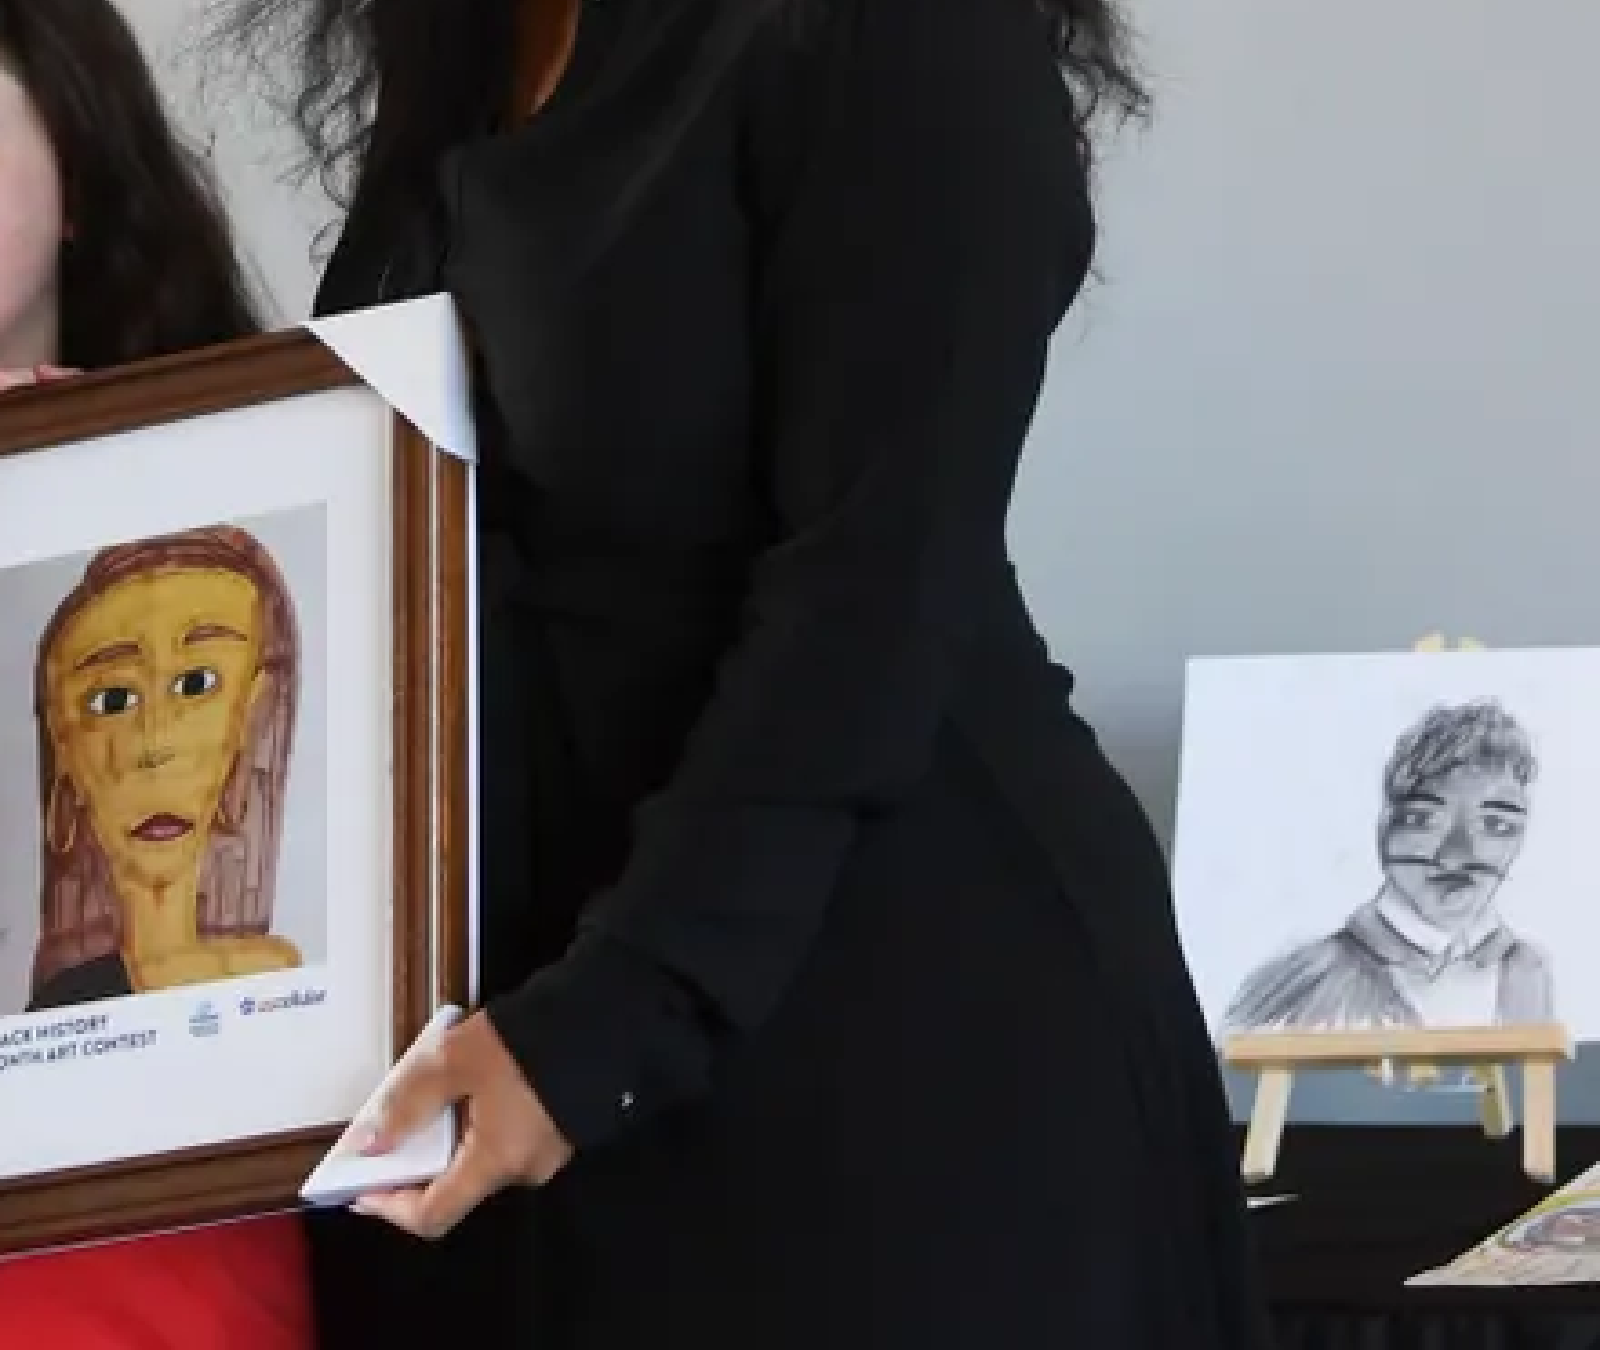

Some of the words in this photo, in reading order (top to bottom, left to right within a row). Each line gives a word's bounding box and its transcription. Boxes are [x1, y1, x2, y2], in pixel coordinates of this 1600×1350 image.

[35, 1014, 109, 1040] HISTORY
[46, 1041, 77, 1061] ART
[83, 1029, 156, 1056] CONTEST
